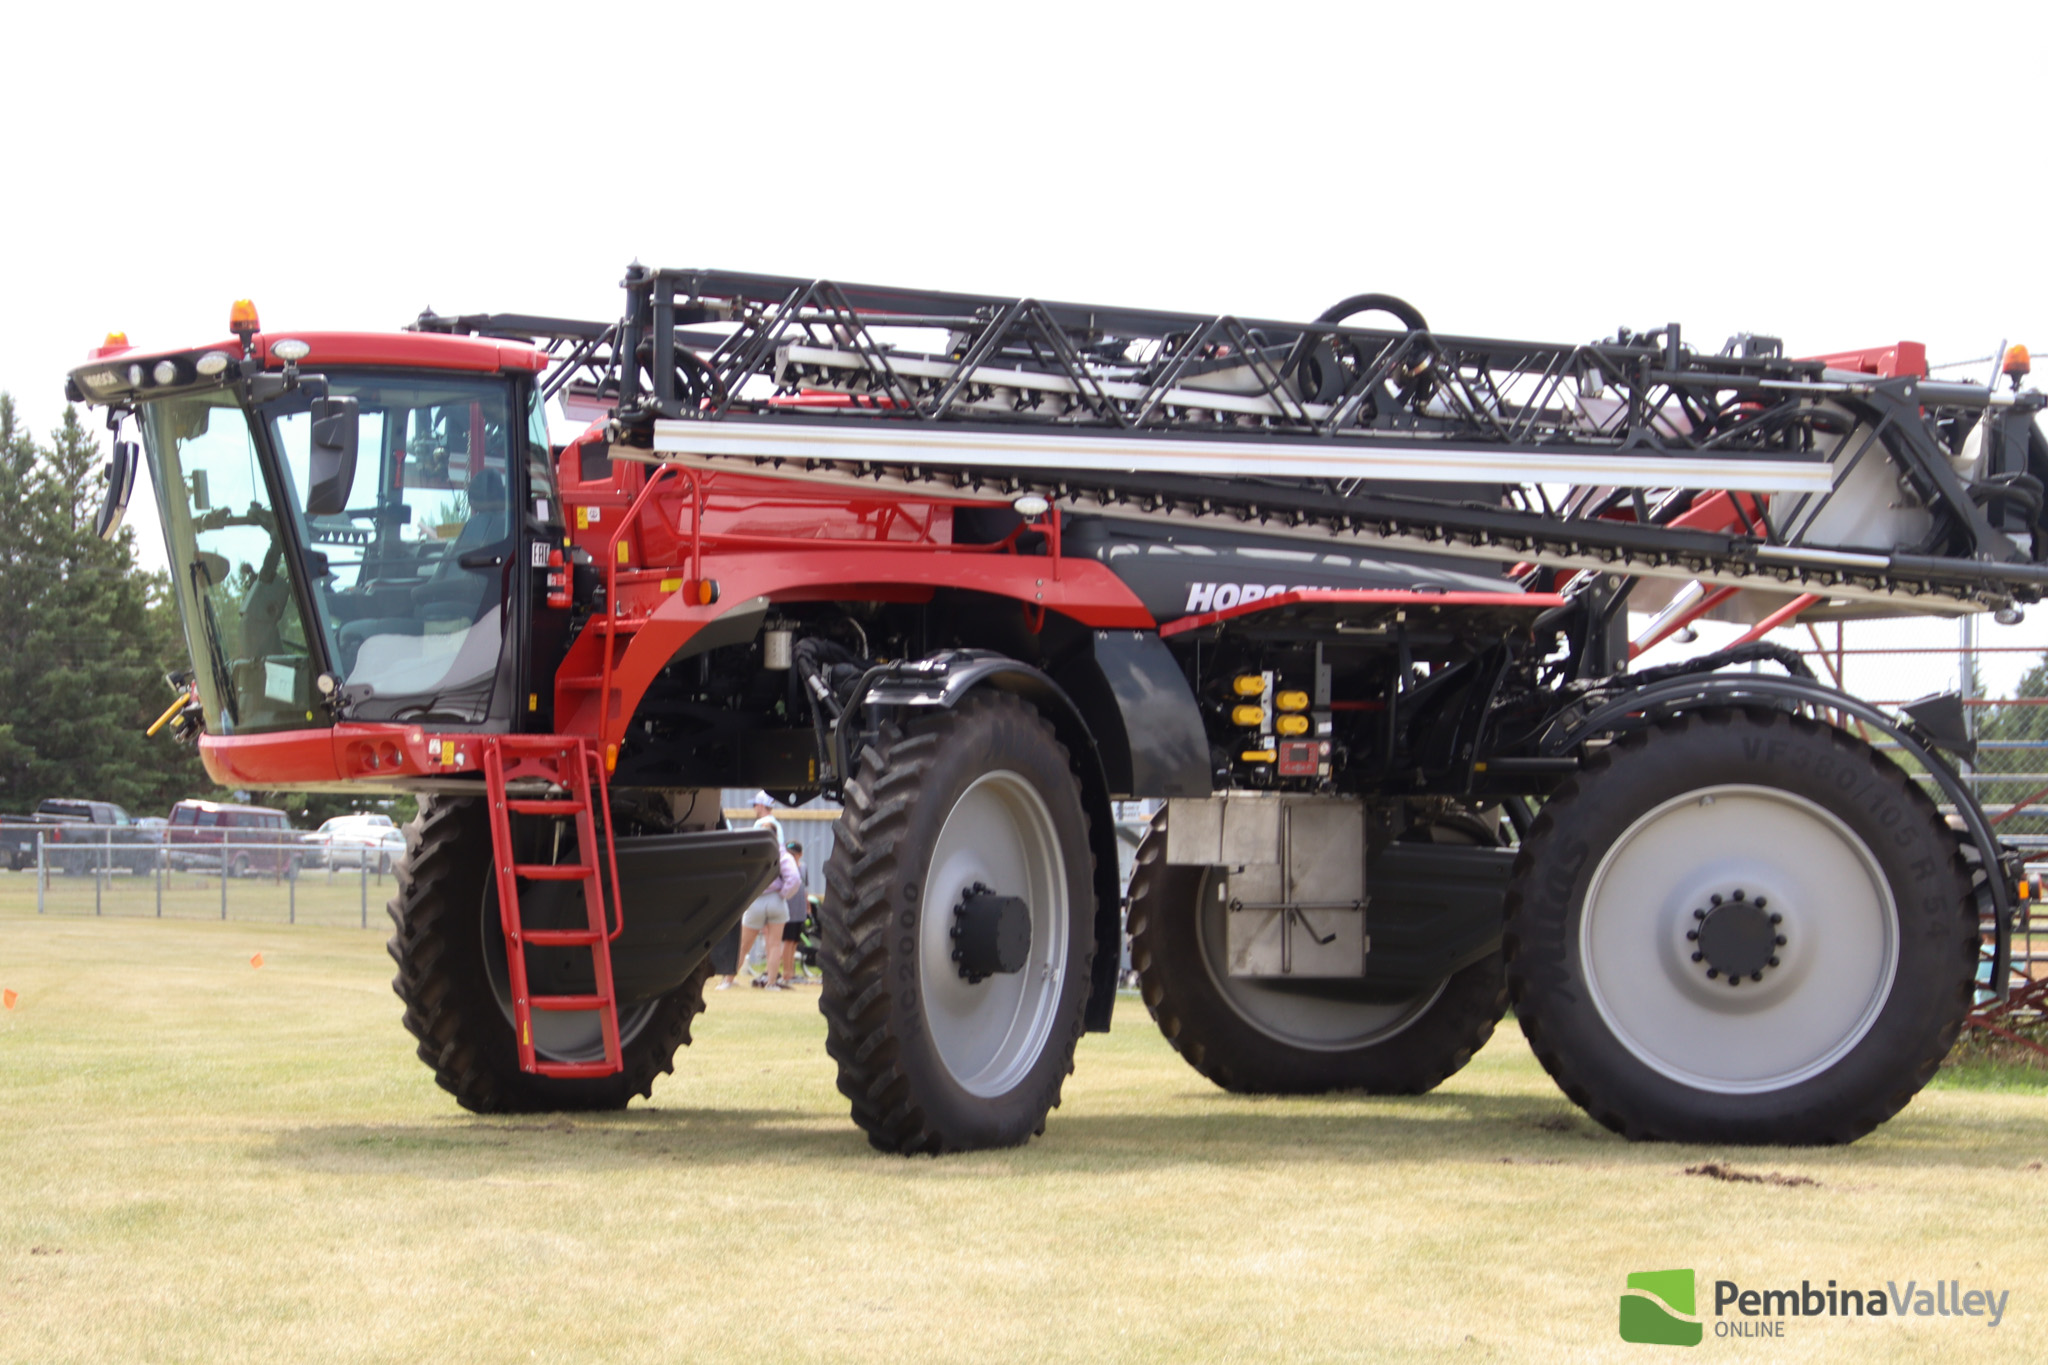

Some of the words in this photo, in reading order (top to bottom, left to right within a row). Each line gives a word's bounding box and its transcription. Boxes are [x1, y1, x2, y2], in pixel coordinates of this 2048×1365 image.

[1185, 582, 1331, 612] HOR
[1742, 737, 1919, 846] VF380/105
[1909, 855, 1936, 881] R
[1922, 895, 1950, 939] 54
